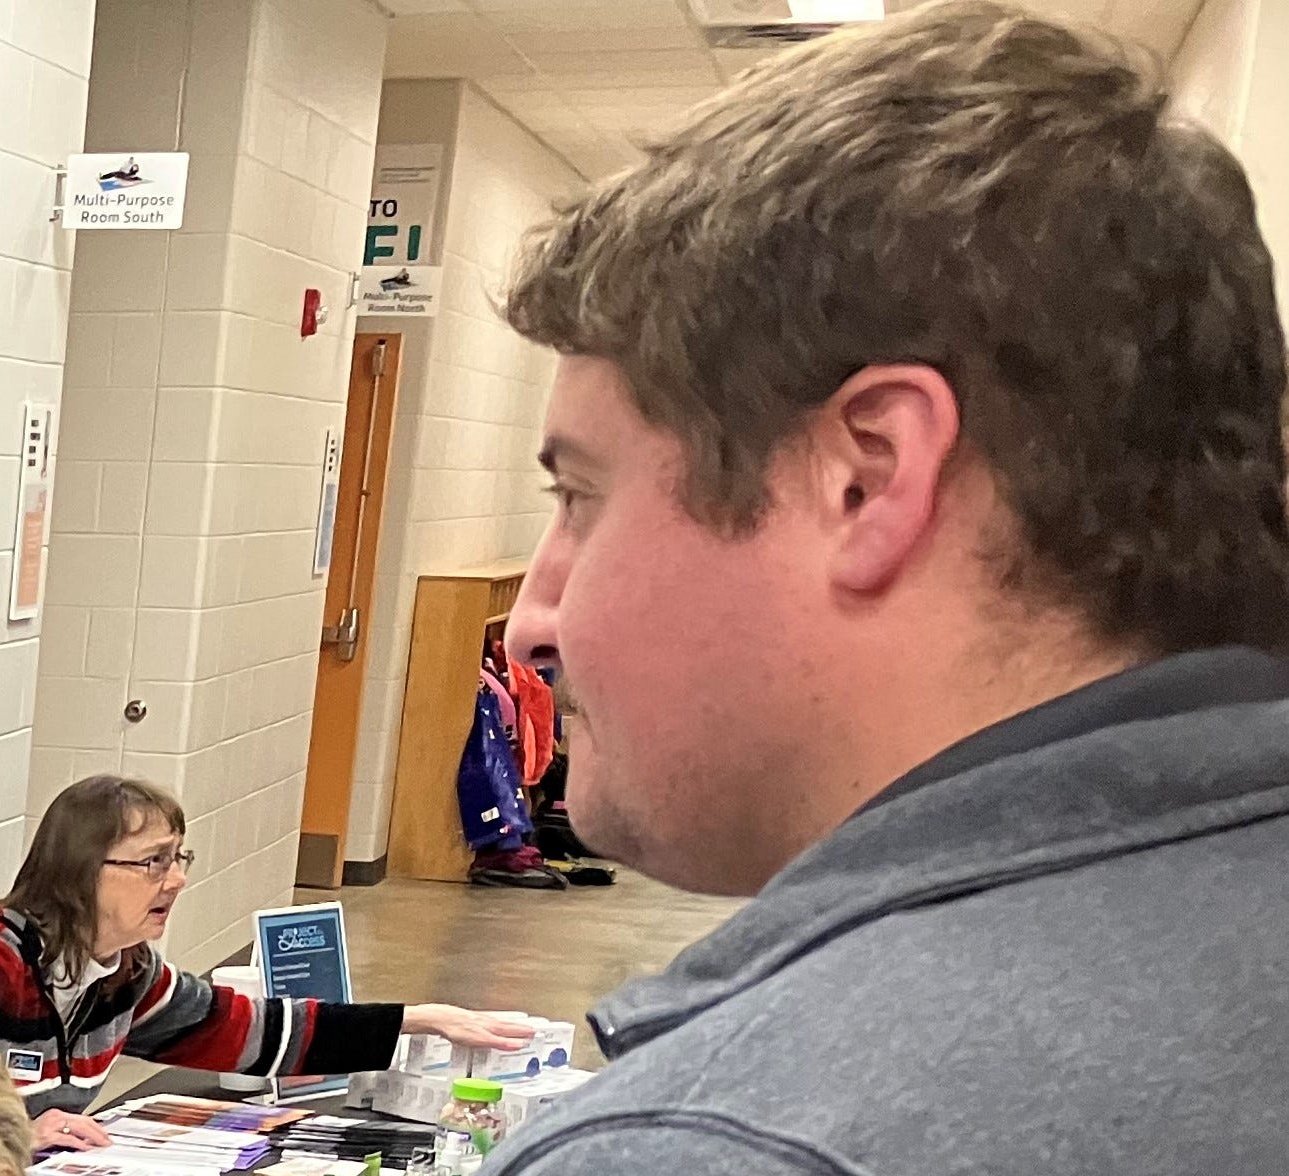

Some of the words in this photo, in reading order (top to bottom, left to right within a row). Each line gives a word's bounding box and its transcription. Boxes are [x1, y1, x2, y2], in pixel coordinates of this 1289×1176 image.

[73, 193, 175, 208] Multi-Purpose
[370, 199, 398, 218] TO
[81, 211, 120, 223] Room
[123, 210, 164, 223] South
[368, 304, 395, 313] Room
[397, 303, 426, 313] North
